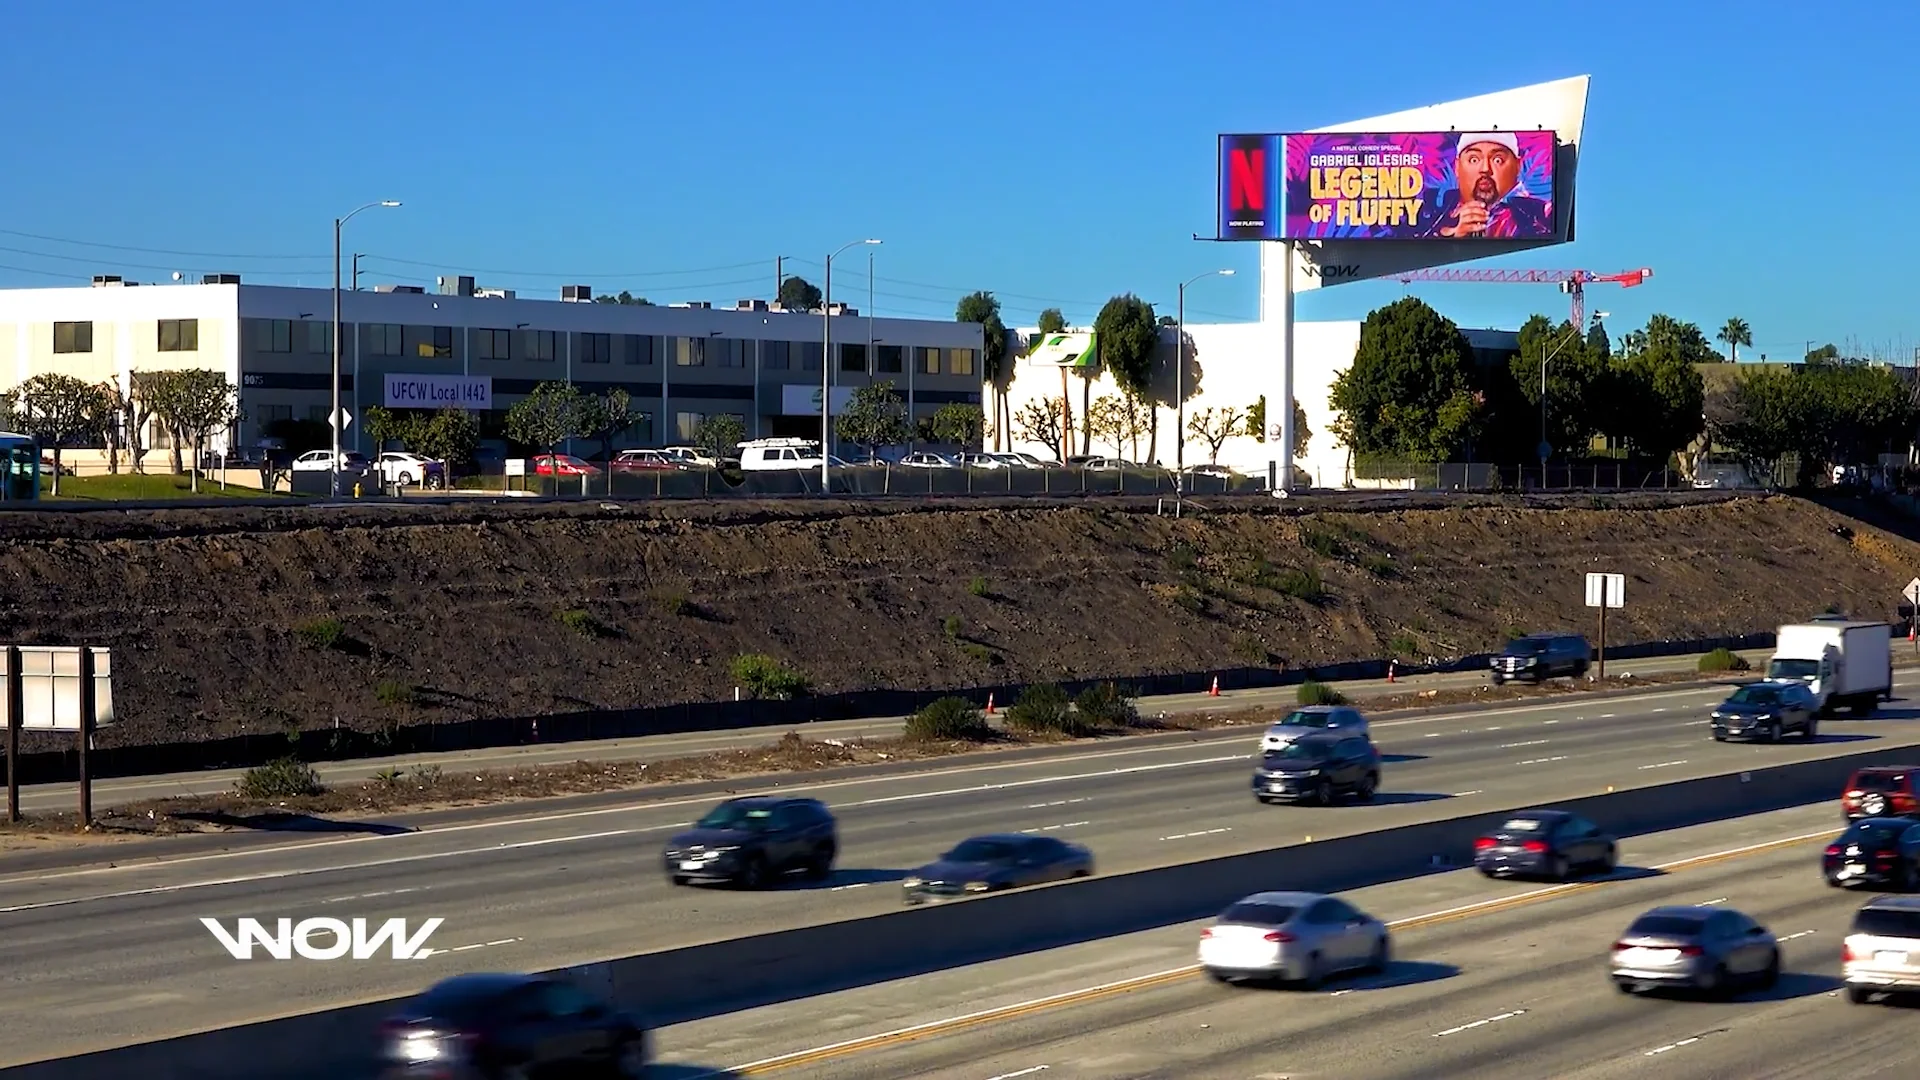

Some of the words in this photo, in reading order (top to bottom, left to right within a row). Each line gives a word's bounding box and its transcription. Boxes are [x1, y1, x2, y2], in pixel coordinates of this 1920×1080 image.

[1310, 155, 1362, 167] GABRIEL
[1364, 154, 1423, 166] IGLESIAS:
[1230, 149, 1264, 210] N
[1310, 166, 1424, 199] LEGEND
[1309, 204, 1333, 223] OF
[1336, 199, 1424, 226] FLUFFY
[392, 382, 427, 400] UFCW
[431, 383, 459, 400] Local
[463, 384, 485, 401] 1442
